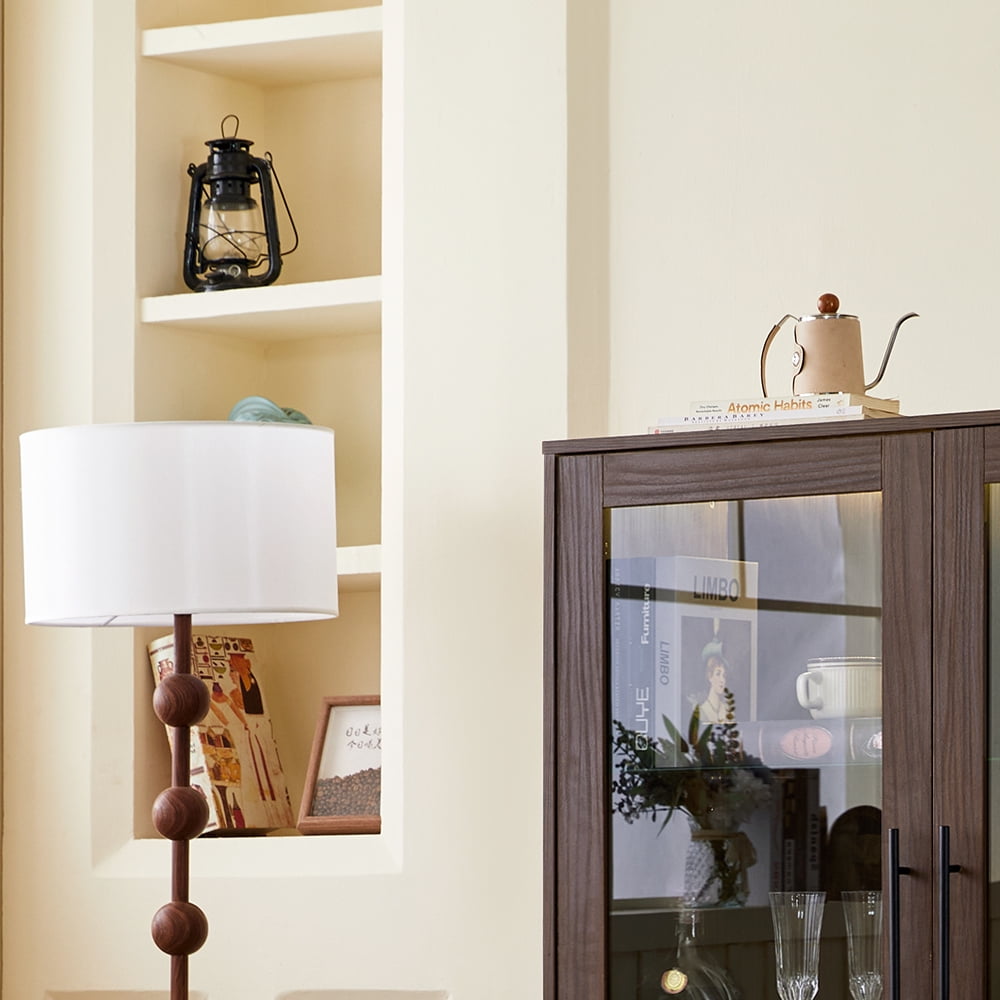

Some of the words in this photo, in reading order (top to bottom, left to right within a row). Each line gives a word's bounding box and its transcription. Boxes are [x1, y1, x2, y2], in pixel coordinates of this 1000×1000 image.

[727, 401, 771, 414] Atomic
[774, 398, 813, 411] Habits
[693, 575, 739, 602] LIMBO
[659, 640, 671, 686] LIMBO
